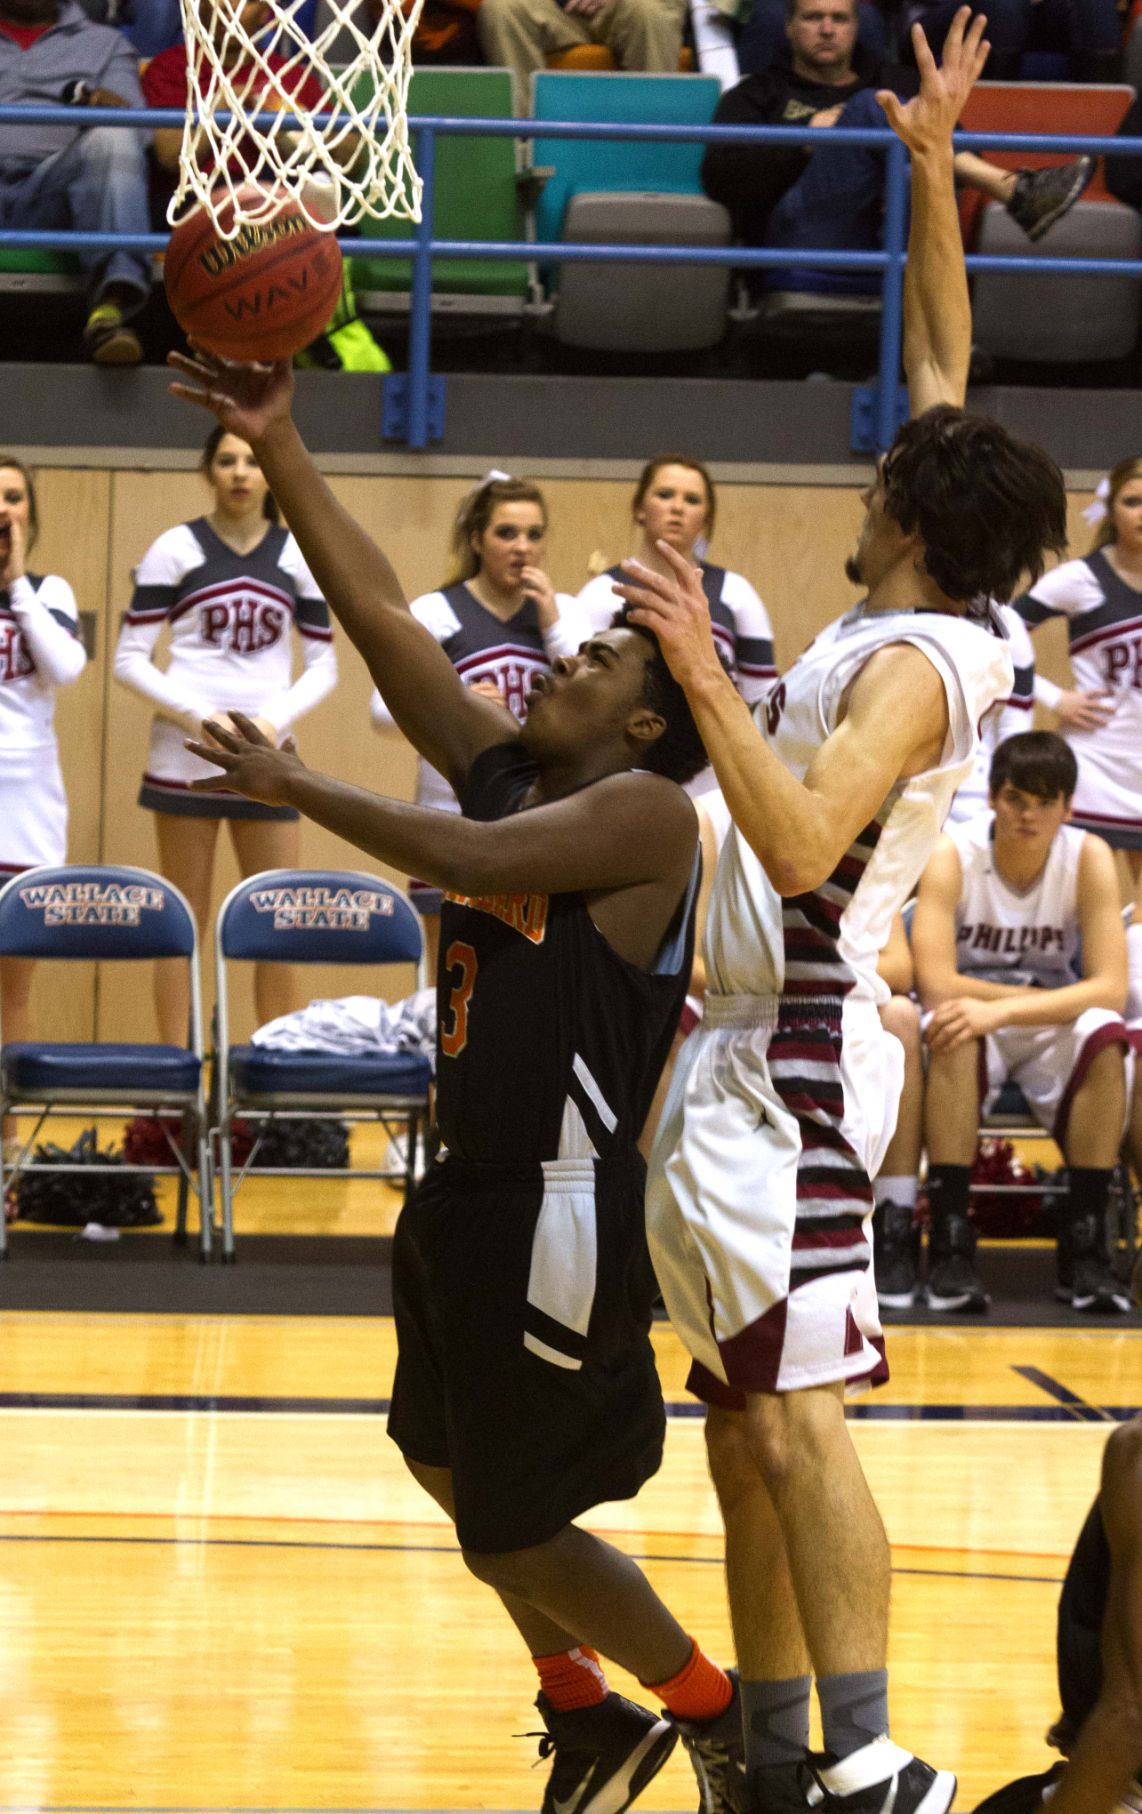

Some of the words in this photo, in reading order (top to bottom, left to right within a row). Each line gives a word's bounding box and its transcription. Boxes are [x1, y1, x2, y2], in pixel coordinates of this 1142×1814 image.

[202, 599, 284, 653] PHS
[20, 882, 165, 912] WALLACE
[250, 886, 395, 917] WALLACE
[44, 902, 142, 927] STATE
[274, 906, 370, 932] STATE
[440, 940, 479, 1059] 3
